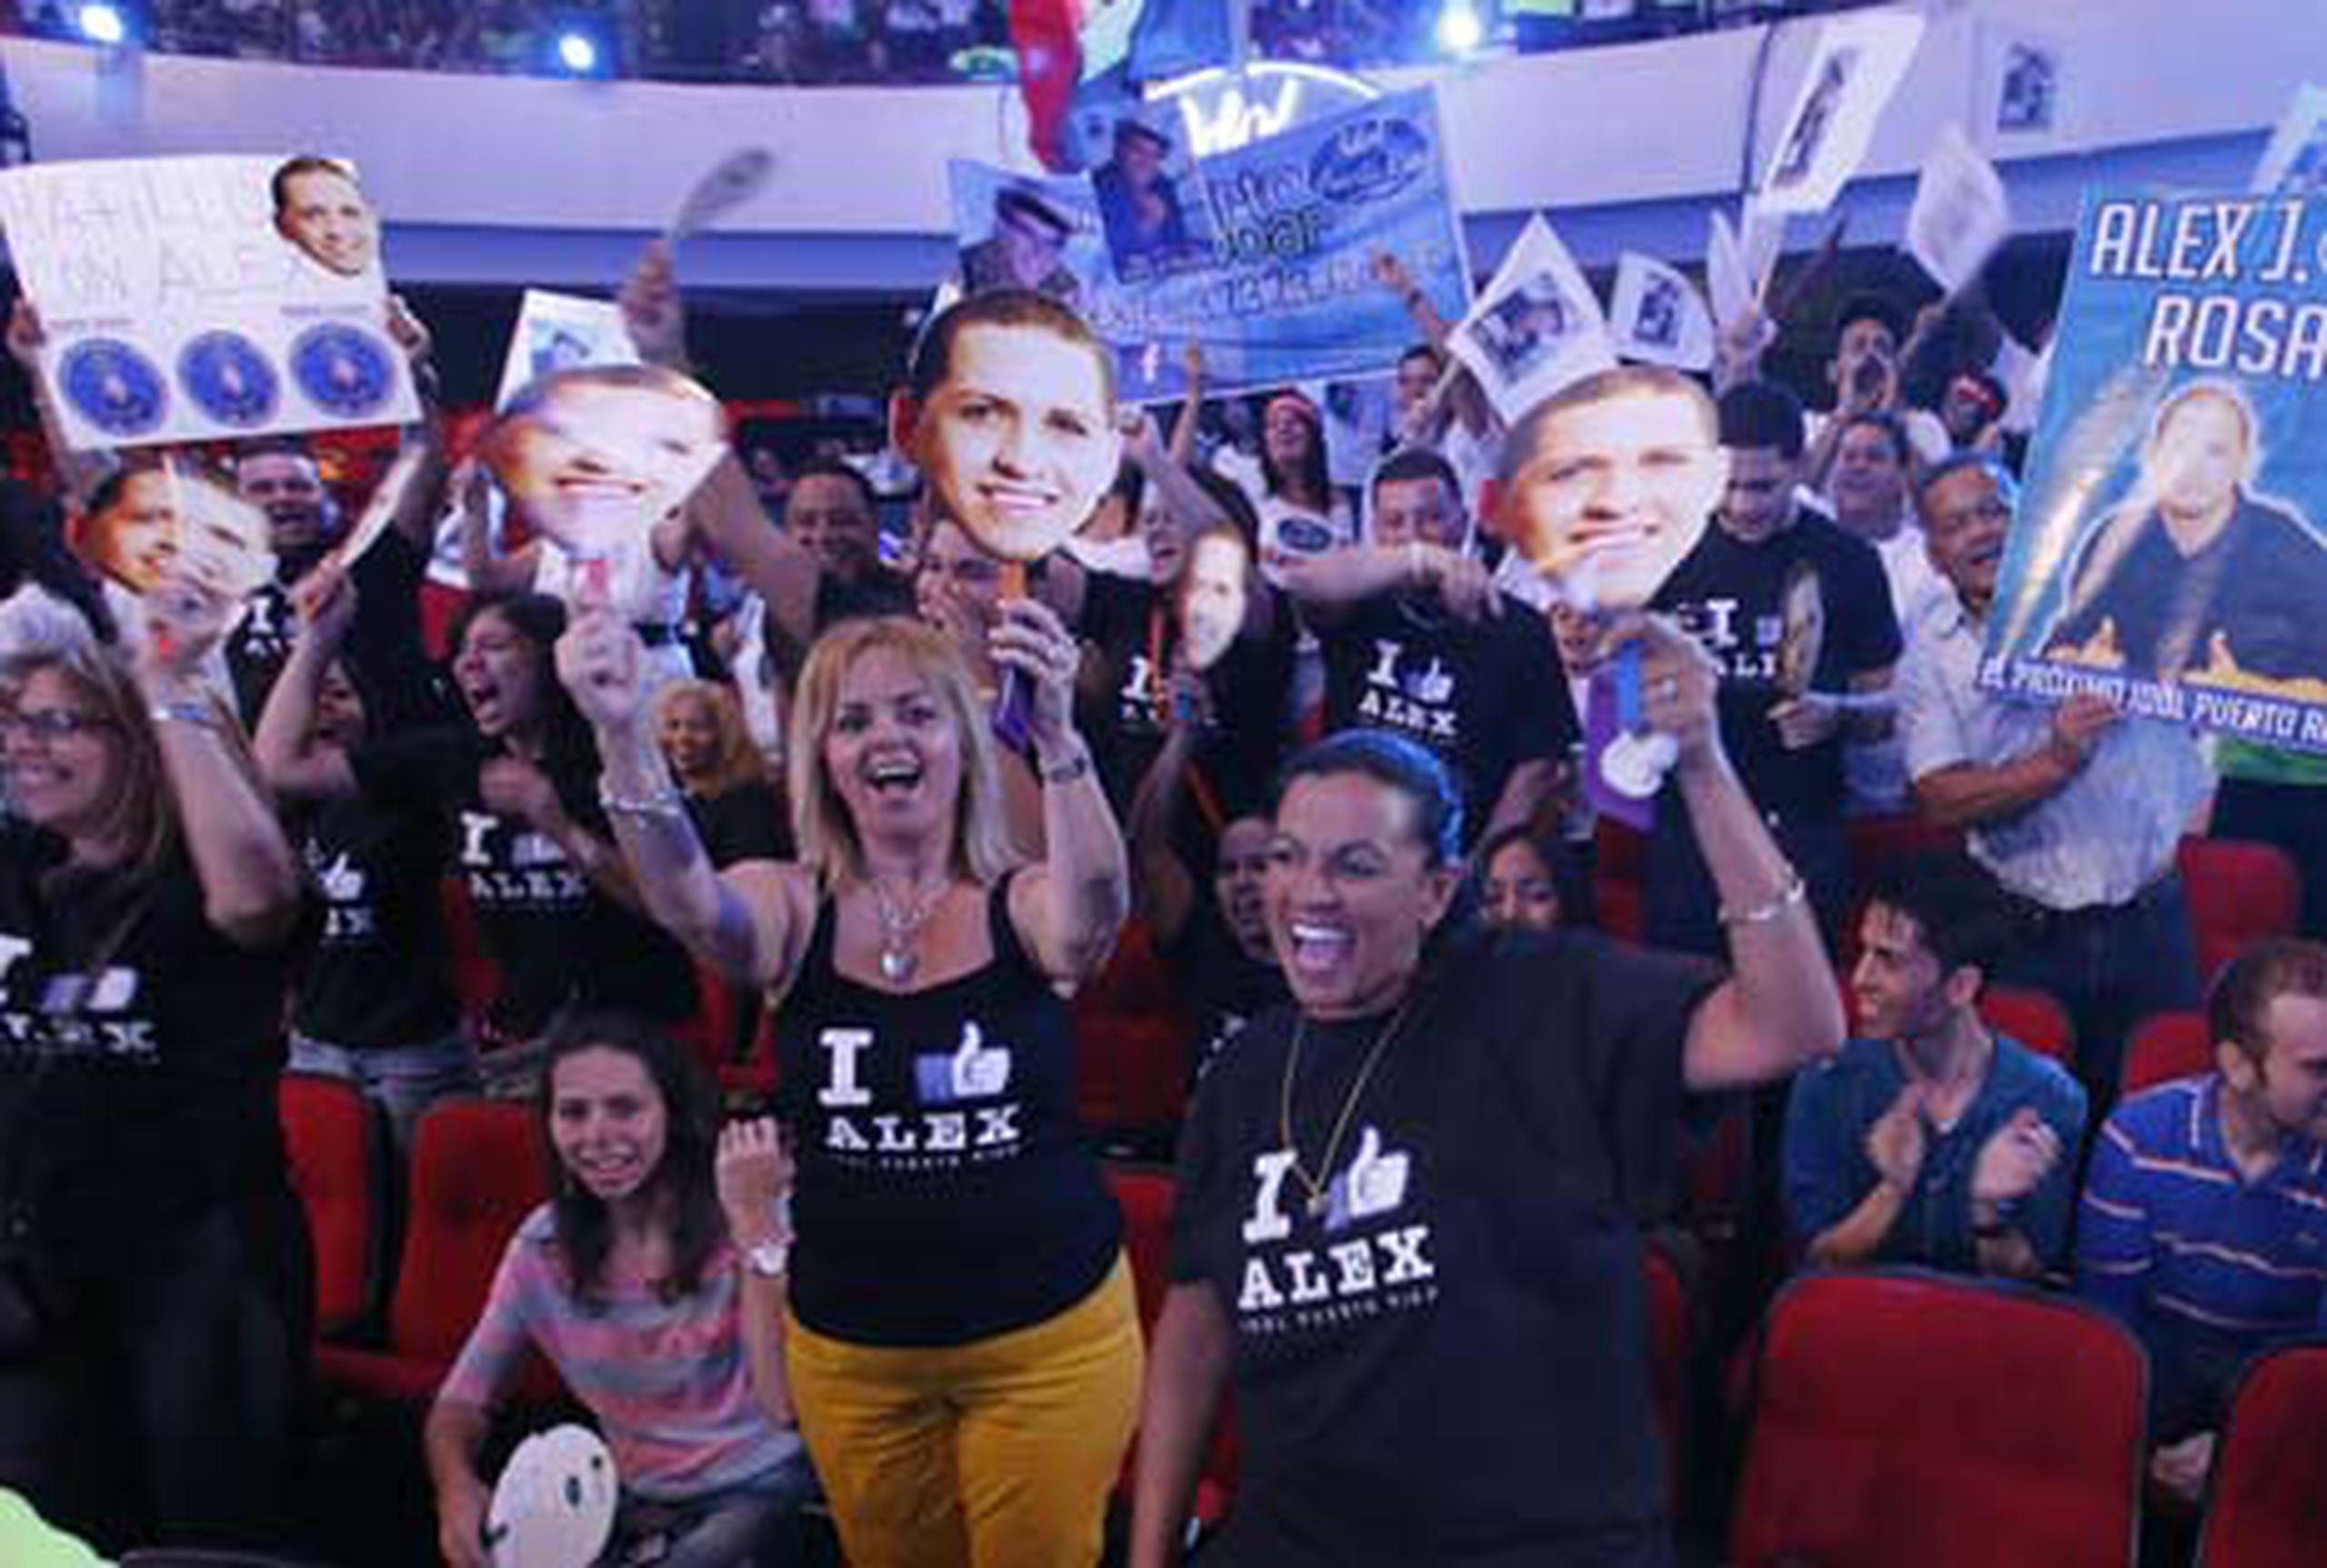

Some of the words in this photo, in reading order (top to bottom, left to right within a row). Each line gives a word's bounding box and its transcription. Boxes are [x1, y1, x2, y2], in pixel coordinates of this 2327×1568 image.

[2092, 203, 2252, 279] ALEX
[2260, 199, 2309, 283] J.
[1365, 638, 1402, 689] I
[1357, 688, 1459, 737] ALEX
[2191, 692, 2299, 739] PUERTO
[2301, 706, 2327, 744] R
[460, 810, 498, 866] I
[819, 1027, 873, 1106] I
[825, 1104, 1021, 1152] ALEX
[1242, 1147, 1298, 1243] I
[1237, 1225, 1436, 1311] ALEX
